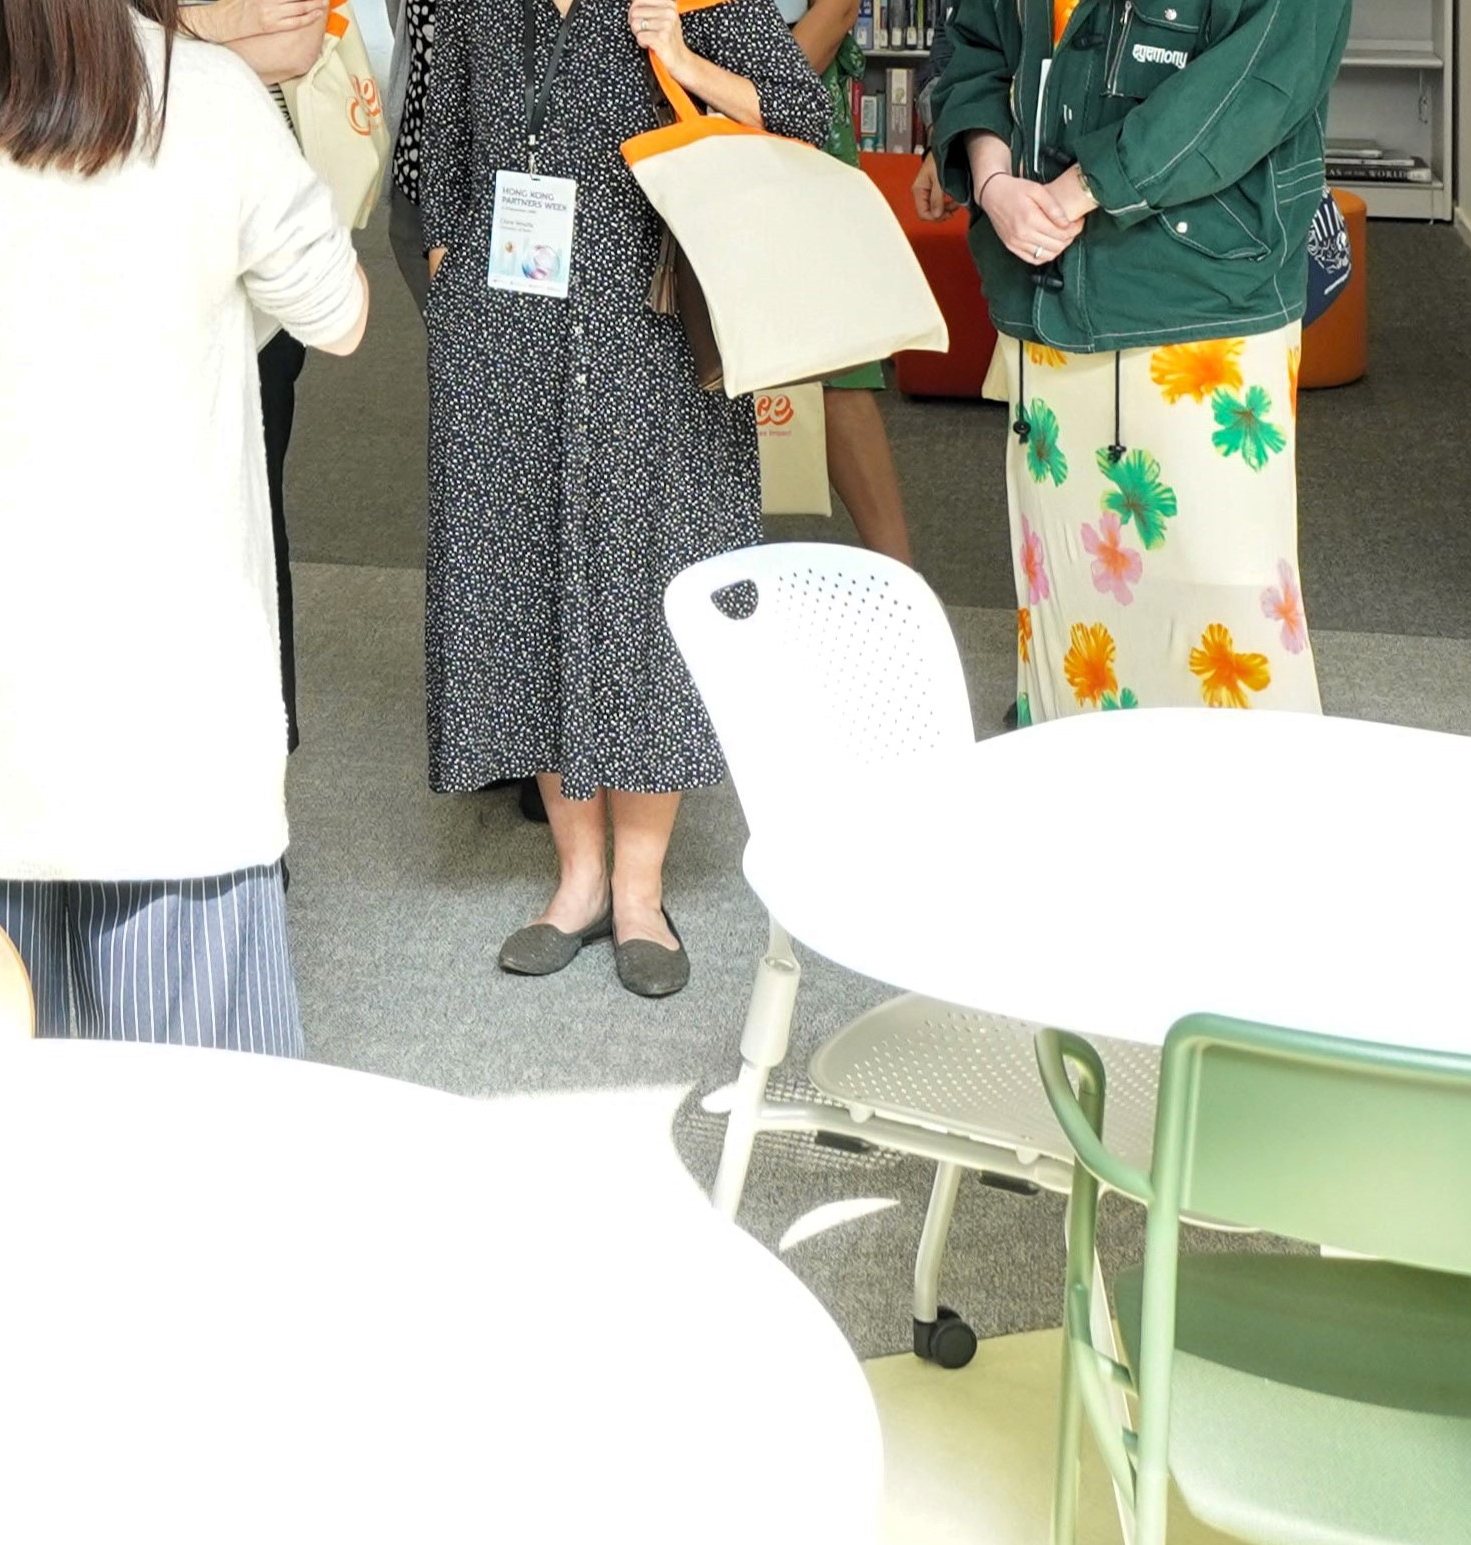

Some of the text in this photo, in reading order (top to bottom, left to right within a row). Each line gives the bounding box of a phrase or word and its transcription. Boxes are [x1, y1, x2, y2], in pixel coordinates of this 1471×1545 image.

[502, 187, 555, 201] HONG KONG
[502, 197, 568, 211] PARTNERS WEEK
